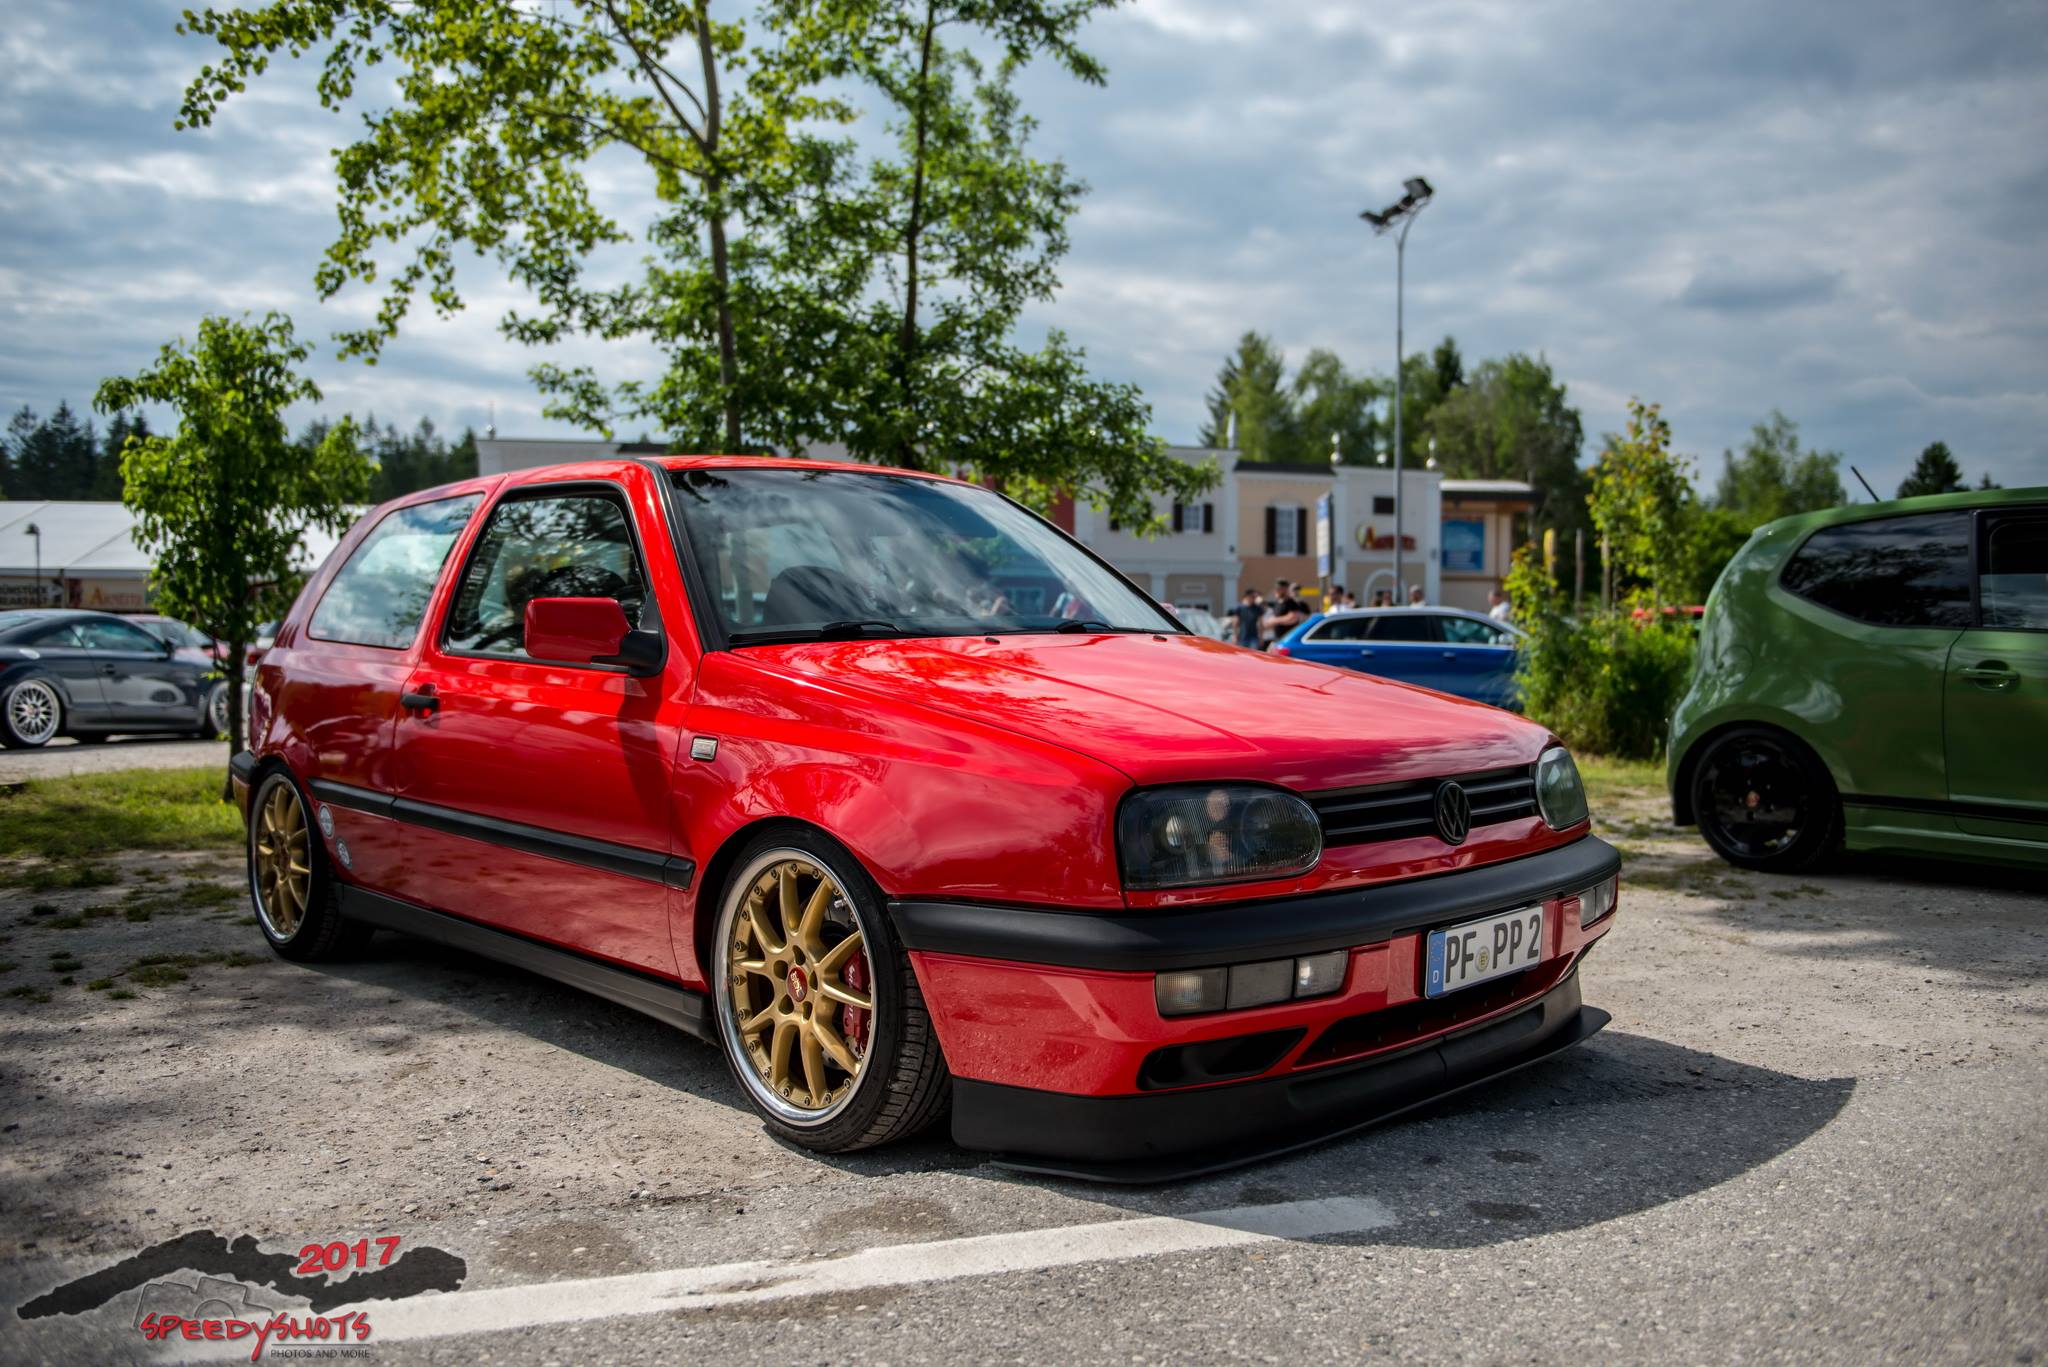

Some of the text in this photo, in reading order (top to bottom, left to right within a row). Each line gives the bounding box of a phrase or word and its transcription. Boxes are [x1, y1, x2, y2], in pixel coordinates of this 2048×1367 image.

[1445, 914, 1541, 984] PF PP 2
[1432, 969, 1440, 984] D
